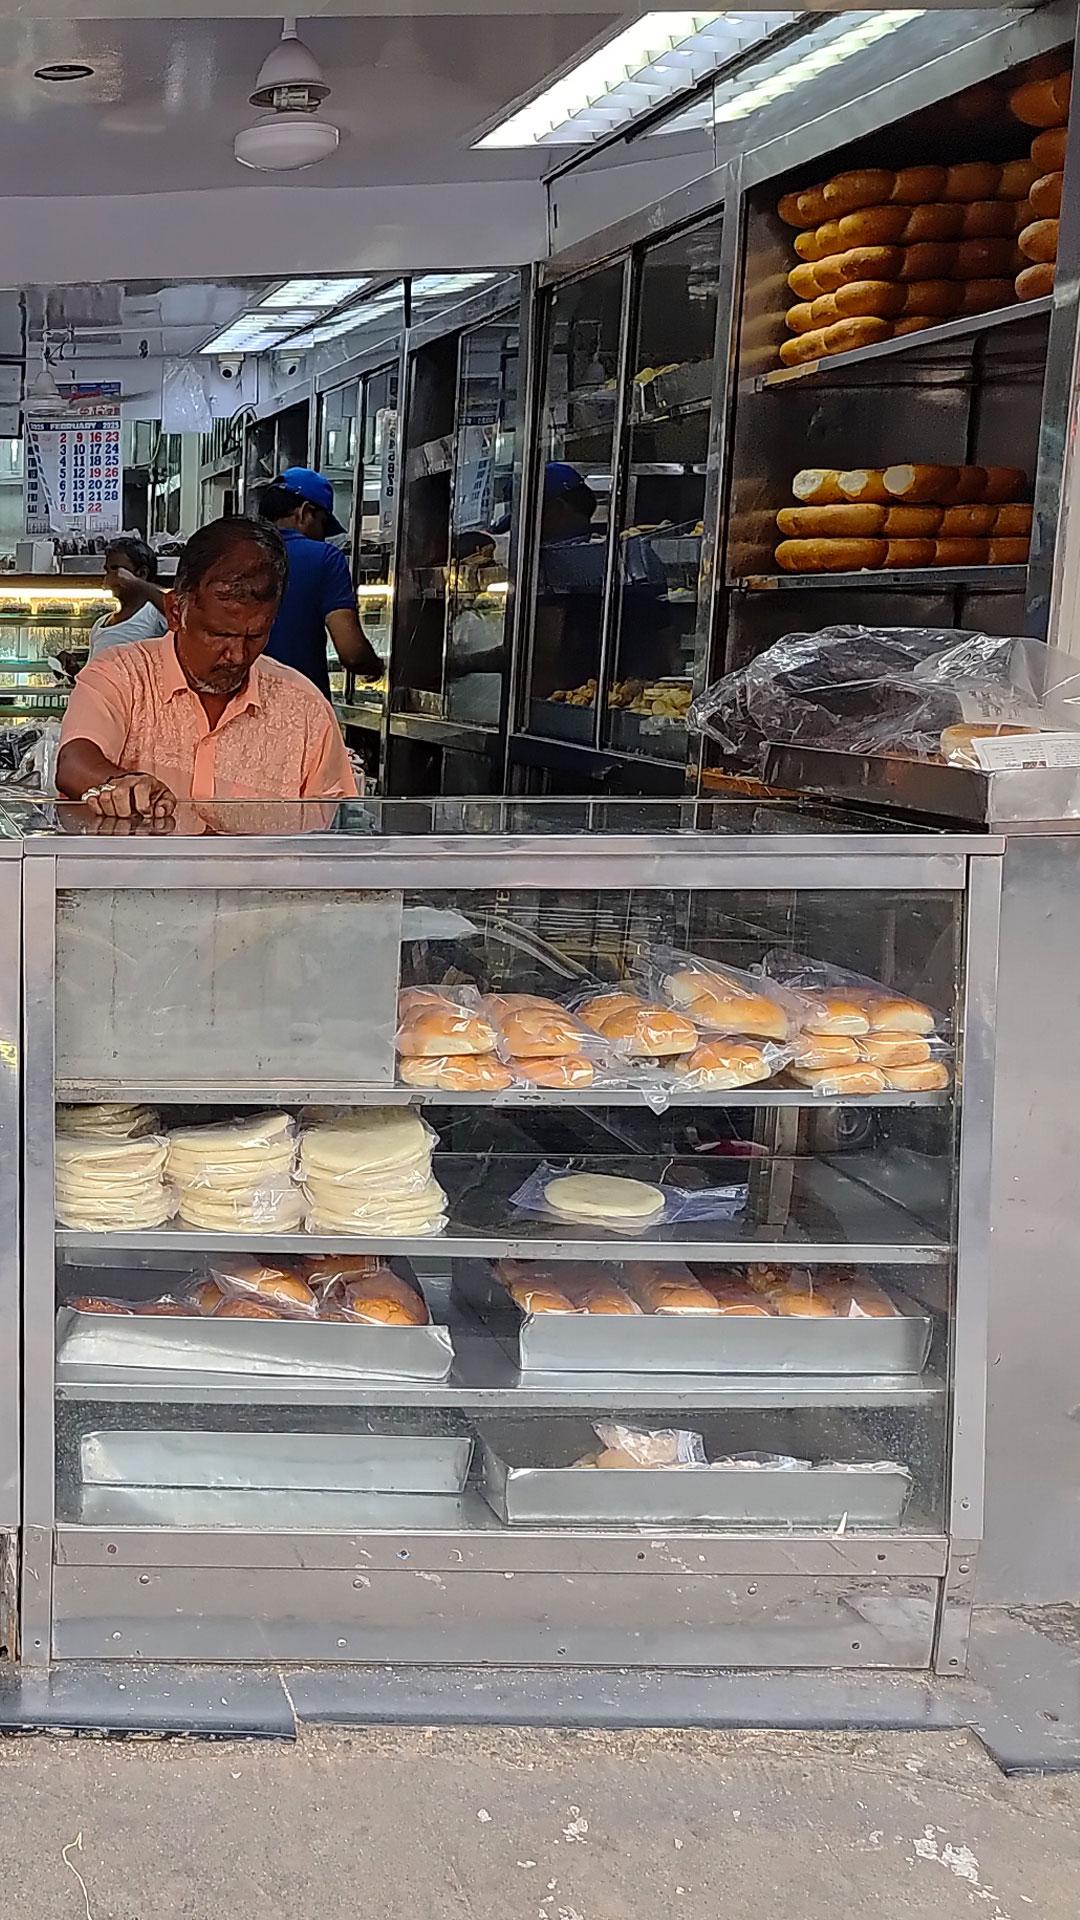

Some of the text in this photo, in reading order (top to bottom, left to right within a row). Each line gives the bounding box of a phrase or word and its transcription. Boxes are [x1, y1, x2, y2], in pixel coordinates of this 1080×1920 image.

[50, 422, 97, 430] FEBRUARY
[60, 432, 119, 443] 2 9 16 23
[59, 443, 118, 456] 3 10 17 24
[60, 456, 118, 467] 4 11 18 25
[60, 467, 118, 478] 5 12 19 26
[60, 479, 118, 490] 6 13 20 27
[60, 492, 65, 502] 7
[73, 492, 84, 502] 14
[89, 491, 101, 501] 21
[105, 491, 118, 500] 28
[73, 503, 84, 513] 15
[88, 503, 101, 513] 22
